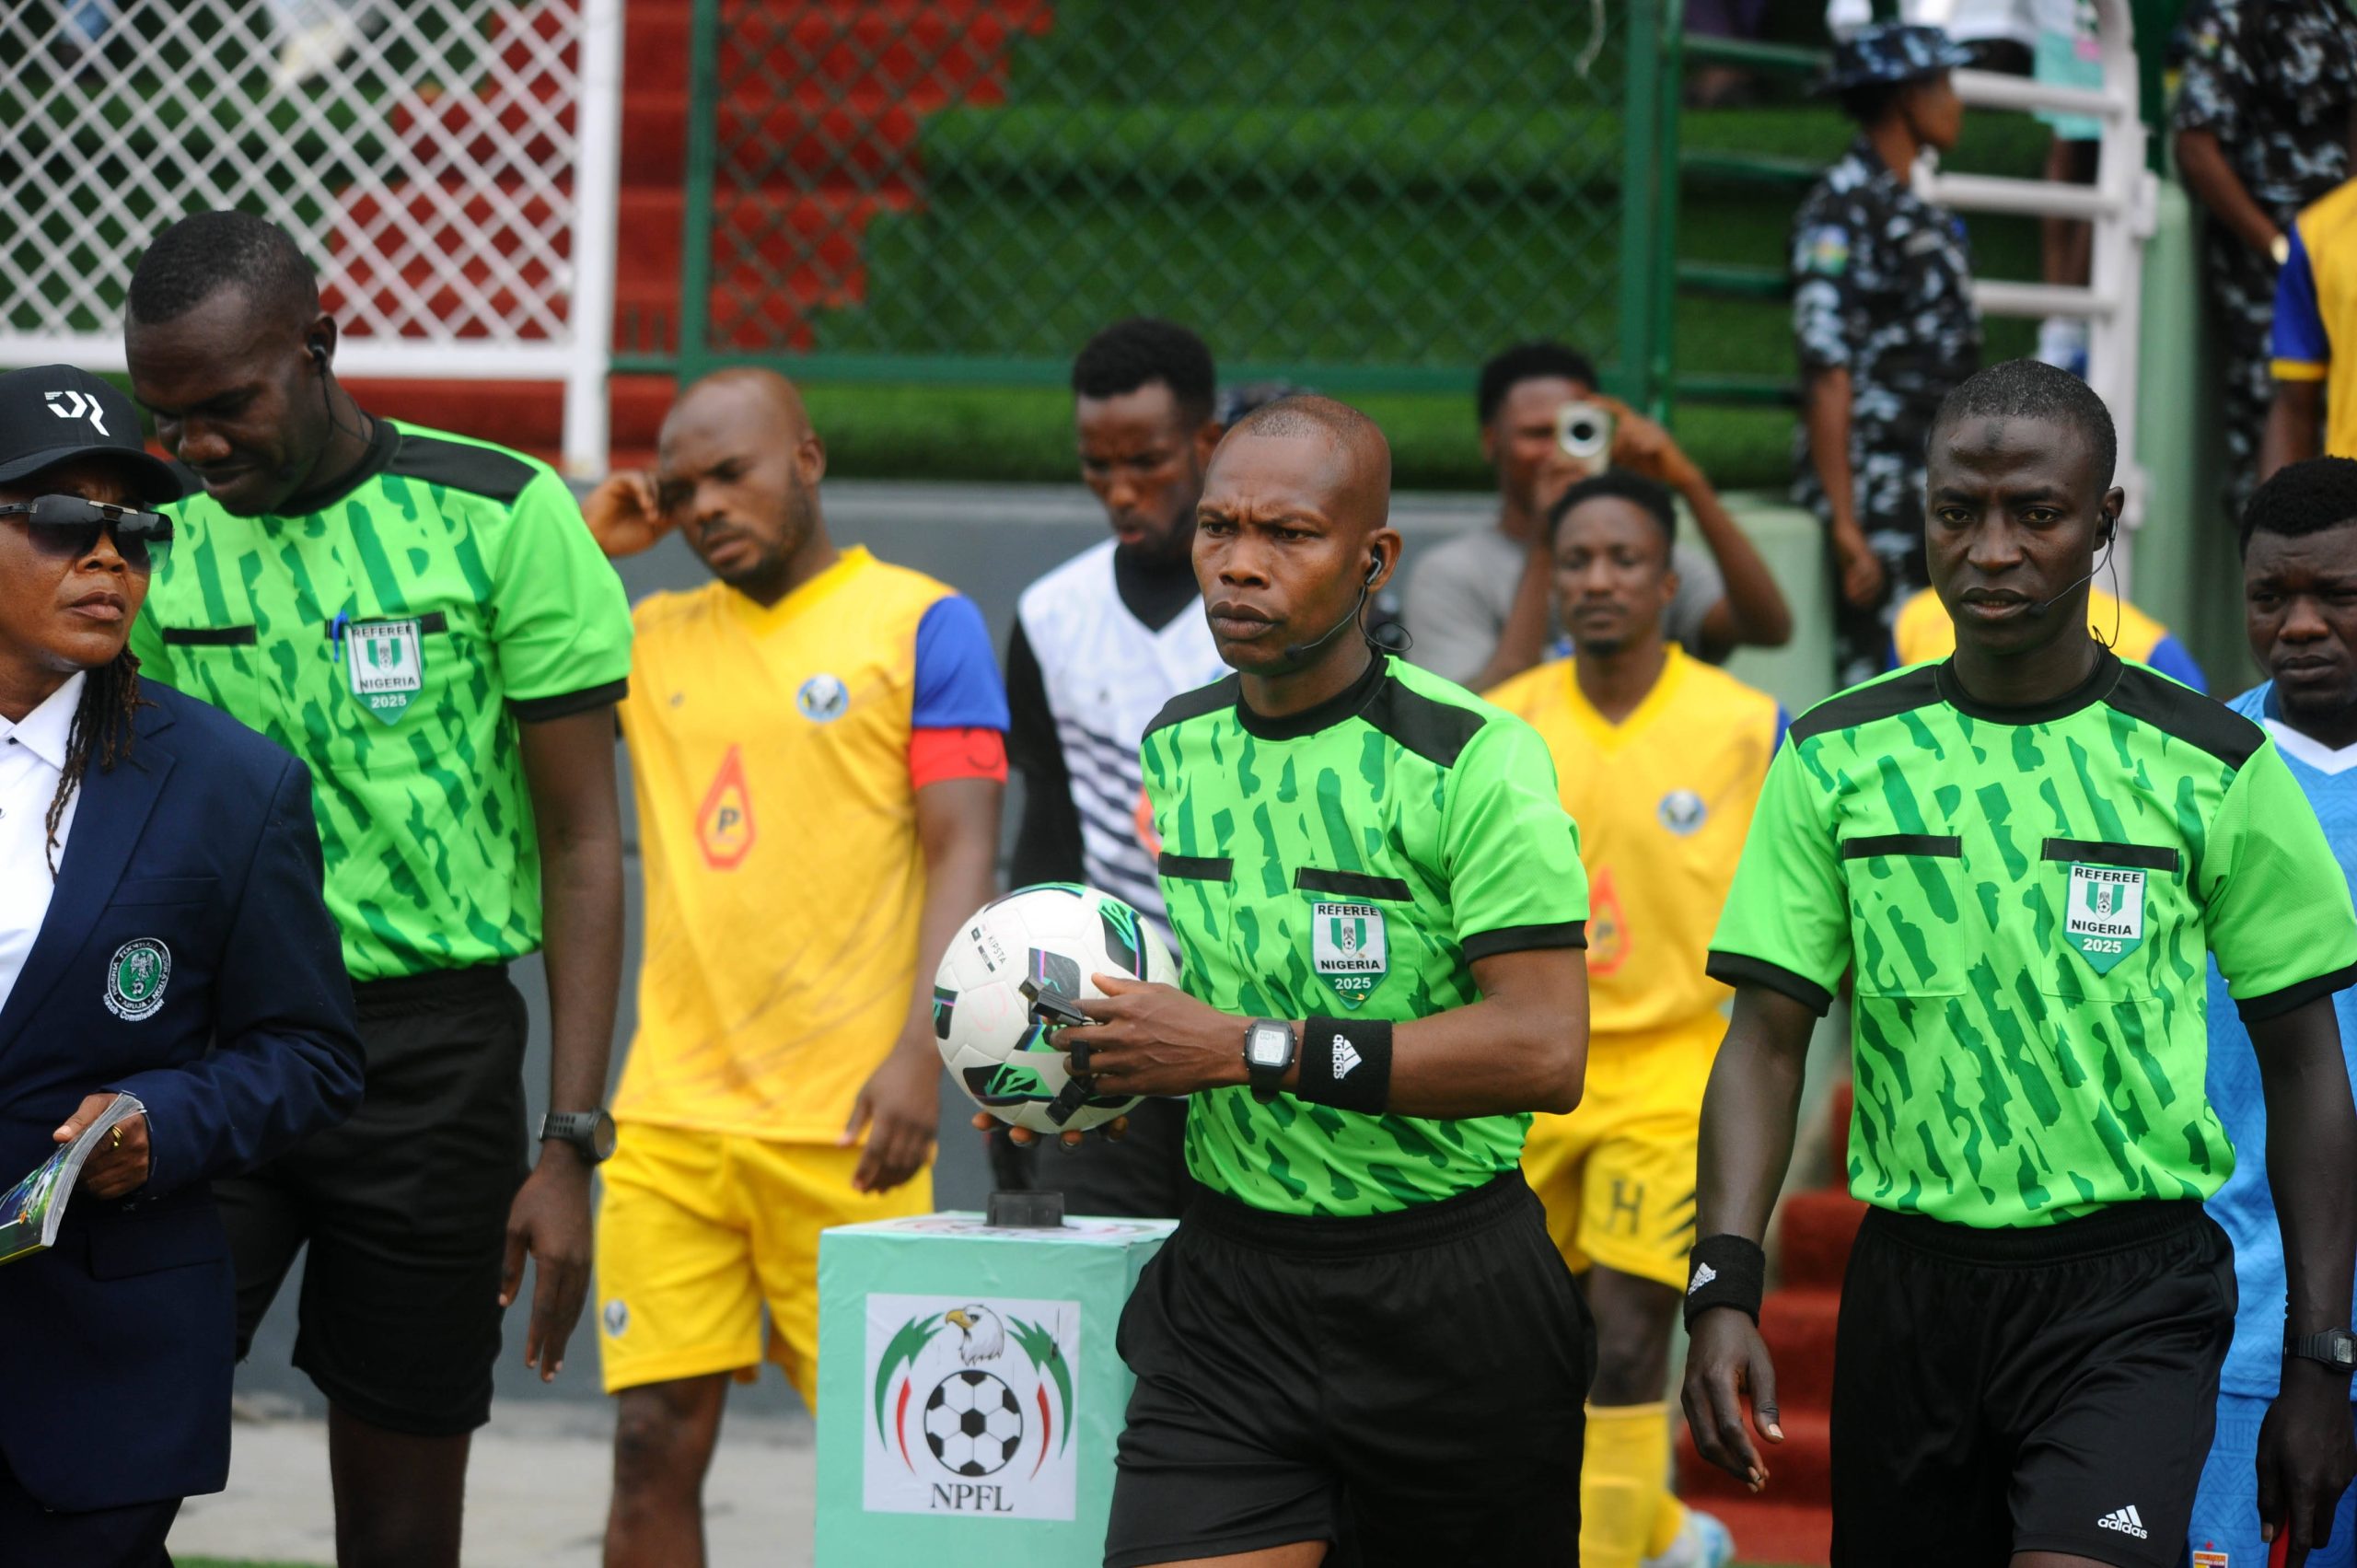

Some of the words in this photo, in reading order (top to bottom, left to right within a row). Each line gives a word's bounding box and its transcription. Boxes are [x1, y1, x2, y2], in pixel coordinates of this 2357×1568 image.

[352, 625, 412, 637] REFEREE
[360, 677, 416, 690] NIGERIA
[371, 694, 407, 709] 2025
[2074, 867, 2141, 883] REFEREE
[1318, 904, 1378, 916] REFEREE
[2072, 919, 2132, 935] NIGERIA
[988, 935, 1006, 964] KIPSTA
[2083, 937, 2122, 953] 2025
[1320, 959, 1380, 970] NIGERIA
[1334, 977, 1372, 989] 2025
[1332, 1034, 1345, 1079] adidas
[930, 1481, 1015, 1513] NPFL
[2097, 1517, 2148, 1539] adidas
